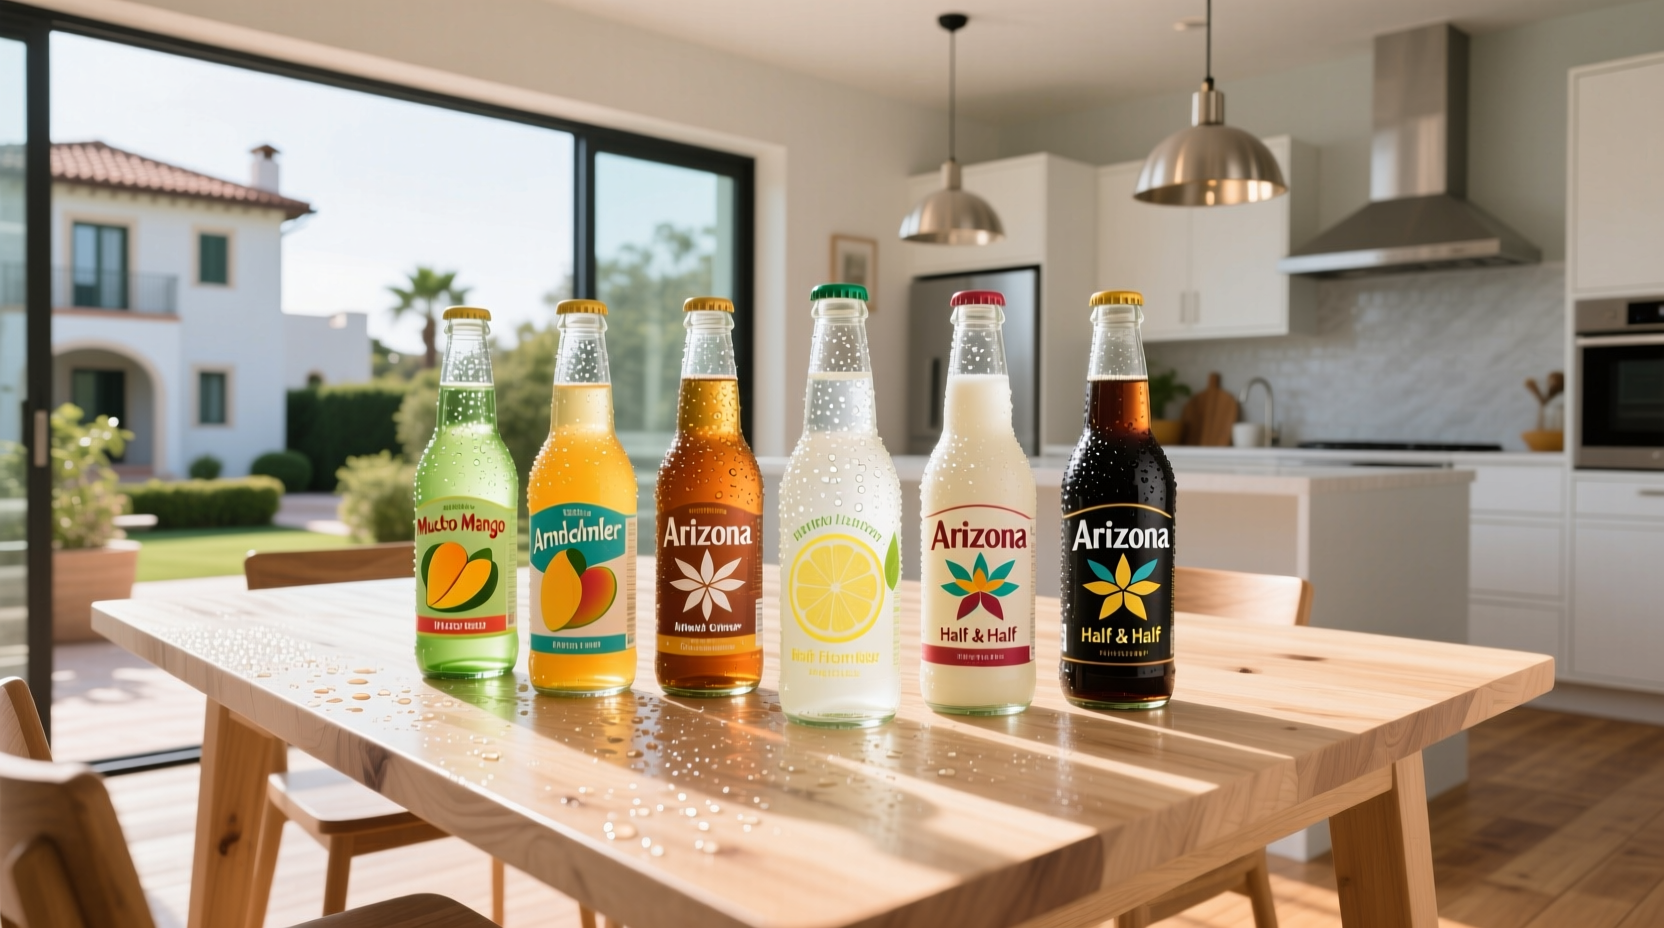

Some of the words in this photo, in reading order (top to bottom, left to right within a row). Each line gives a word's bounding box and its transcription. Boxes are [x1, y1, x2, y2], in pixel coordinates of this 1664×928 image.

[461, 513, 505, 539] Mango
[663, 516, 753, 547] Arizona
[931, 520, 1027, 550] Arizona
[1072, 519, 1170, 551] Arizona
[940, 627, 968, 642] Half
[972, 628, 984, 643] &
[987, 626, 1017, 642] Half
[1081, 627, 1112, 643] Half
[1115, 628, 1128, 644] &
[1132, 626, 1161, 644] Half
